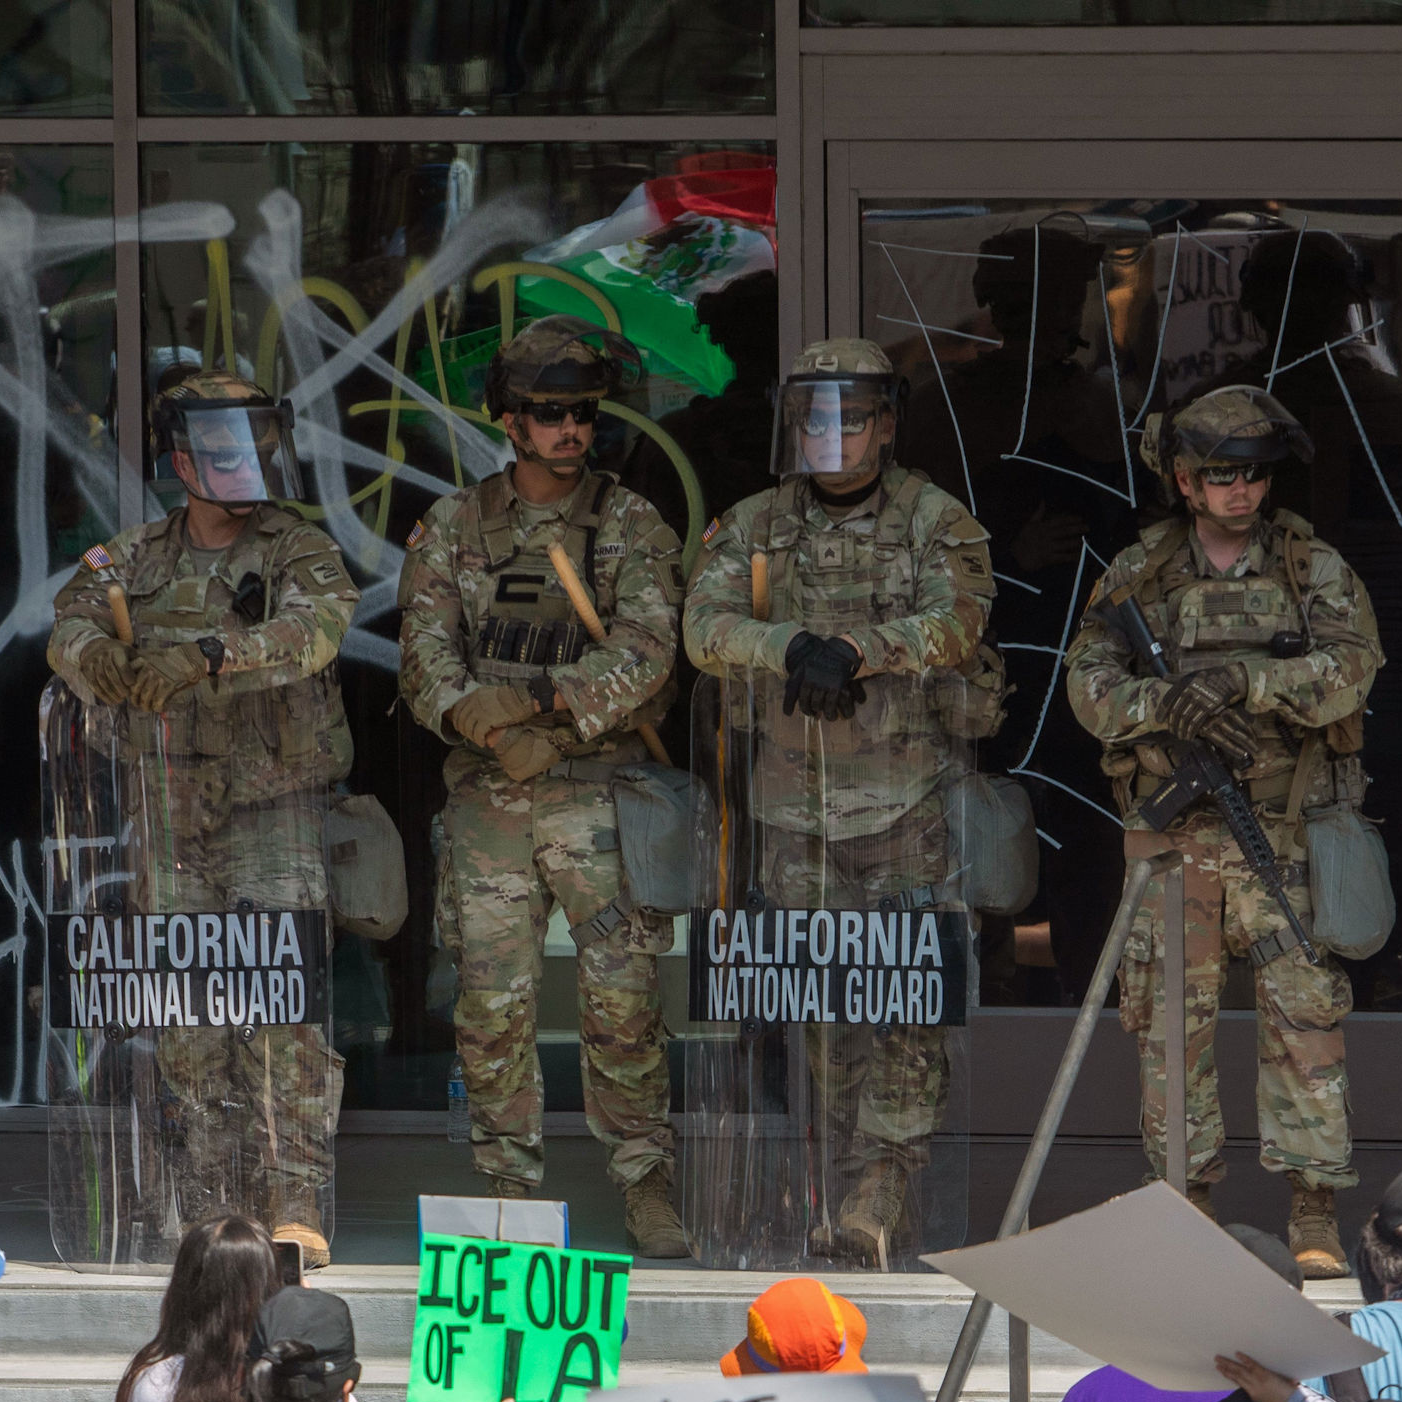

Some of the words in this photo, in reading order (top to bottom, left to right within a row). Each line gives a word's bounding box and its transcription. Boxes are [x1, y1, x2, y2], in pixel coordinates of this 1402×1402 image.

[67, 912, 302, 971] CALIFORNIA
[708, 909, 942, 967] CALIFORNIA
[69, 972, 200, 1028] NATIONAL
[206, 970, 305, 1027] GUARD
[708, 967, 836, 1023] NATIONAL
[845, 970, 944, 1025] GUARD
[419, 1243, 511, 1324] ICE
[525, 1251, 630, 1332] OUT
[425, 1323, 471, 1390] OF
